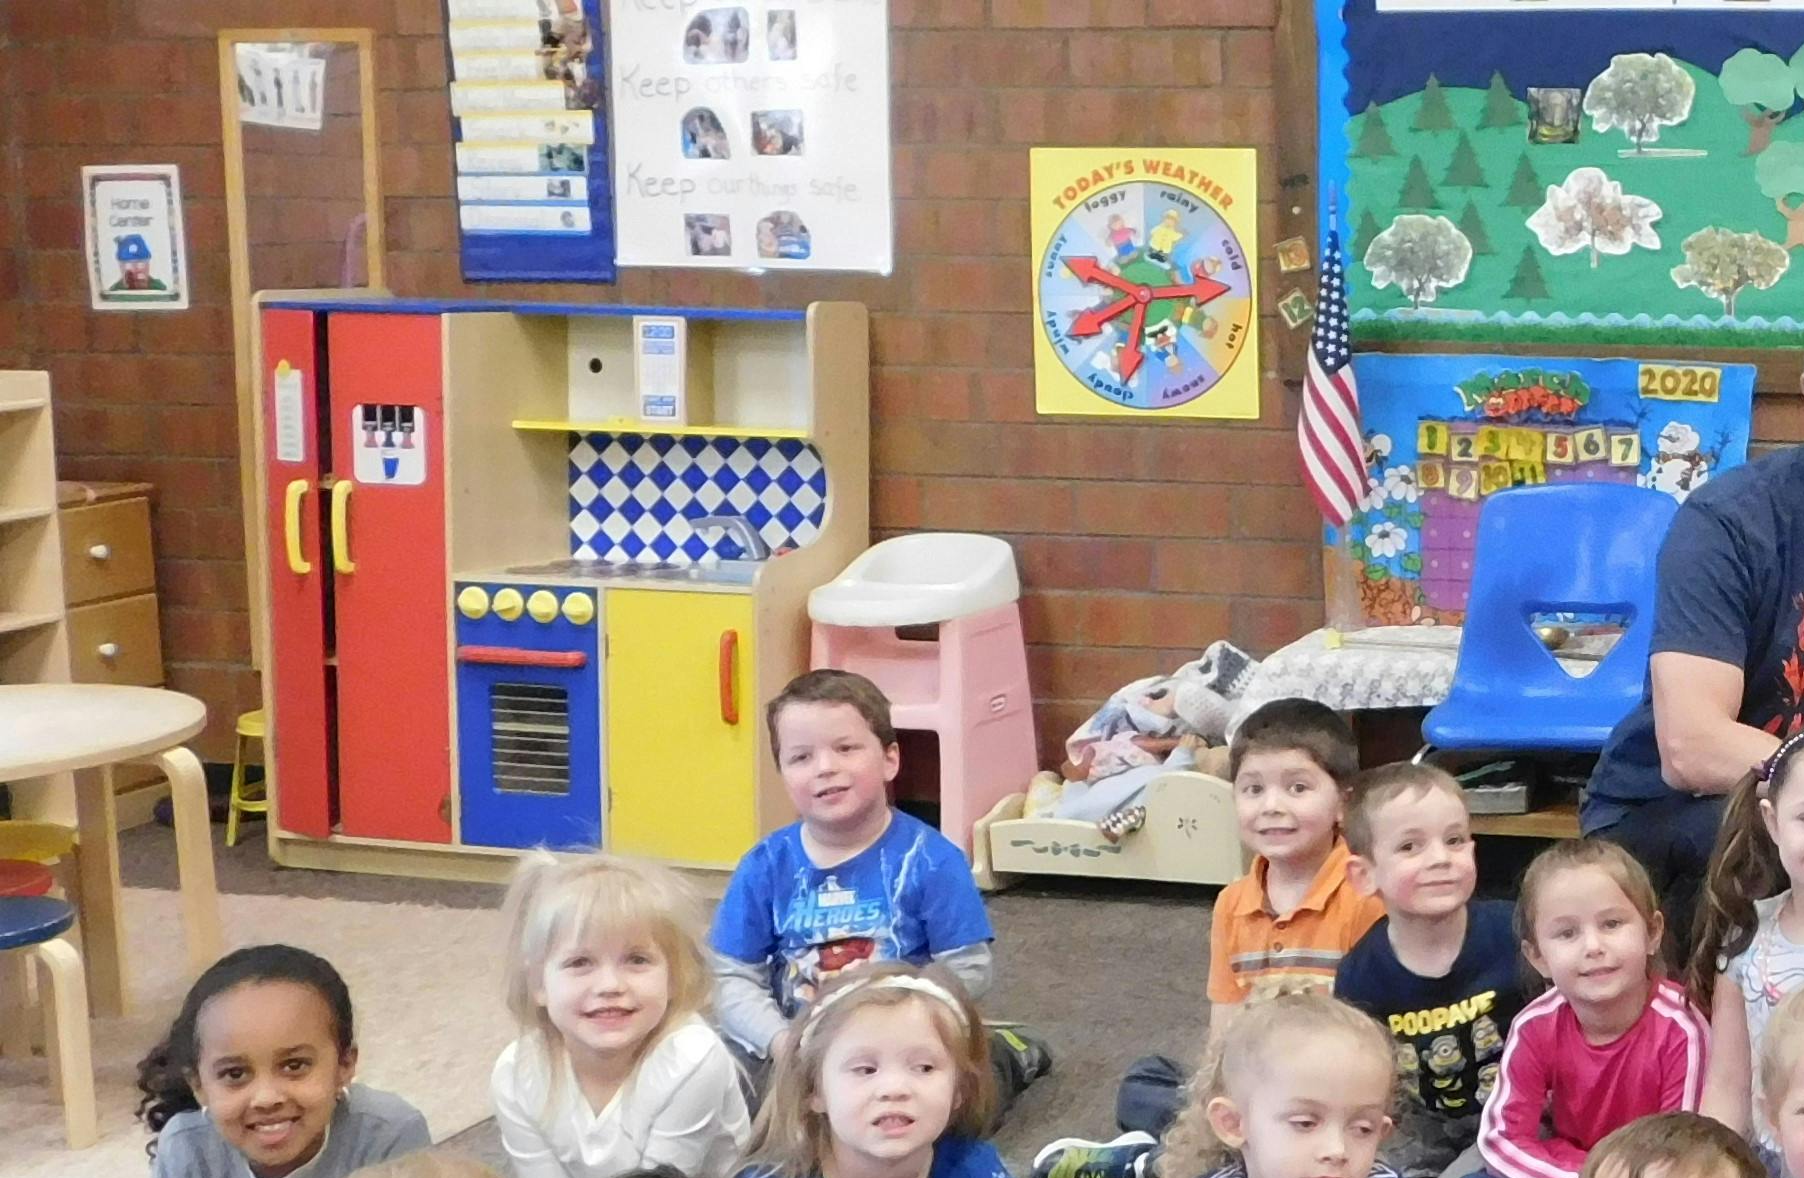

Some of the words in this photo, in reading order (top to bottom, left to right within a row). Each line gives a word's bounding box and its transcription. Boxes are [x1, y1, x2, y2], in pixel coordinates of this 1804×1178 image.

[619, 64, 692, 101] Keep
[800, 63, 858, 95] safe
[626, 163, 697, 204] Keep
[1052, 159, 1135, 211] TODAY'S
[1143, 158, 1235, 211] WEATHER
[1083, 190, 1127, 213] foggy
[1160, 190, 1200, 214] rainy
[1046, 233, 1068, 278] sunny
[1221, 239, 1243, 271] cold
[1046, 310, 1070, 355] windy
[1225, 323, 1243, 350] hot
[1087, 372, 1135, 402] cloudy
[1162, 374, 1206, 400] snowy
[1640, 367, 1719, 399] 2020
[1456, 438, 1473, 458] 2
[1553, 435, 1569, 459] 5
[1583, 431, 1600, 456] 6
[1618, 437, 1634, 461] 7
